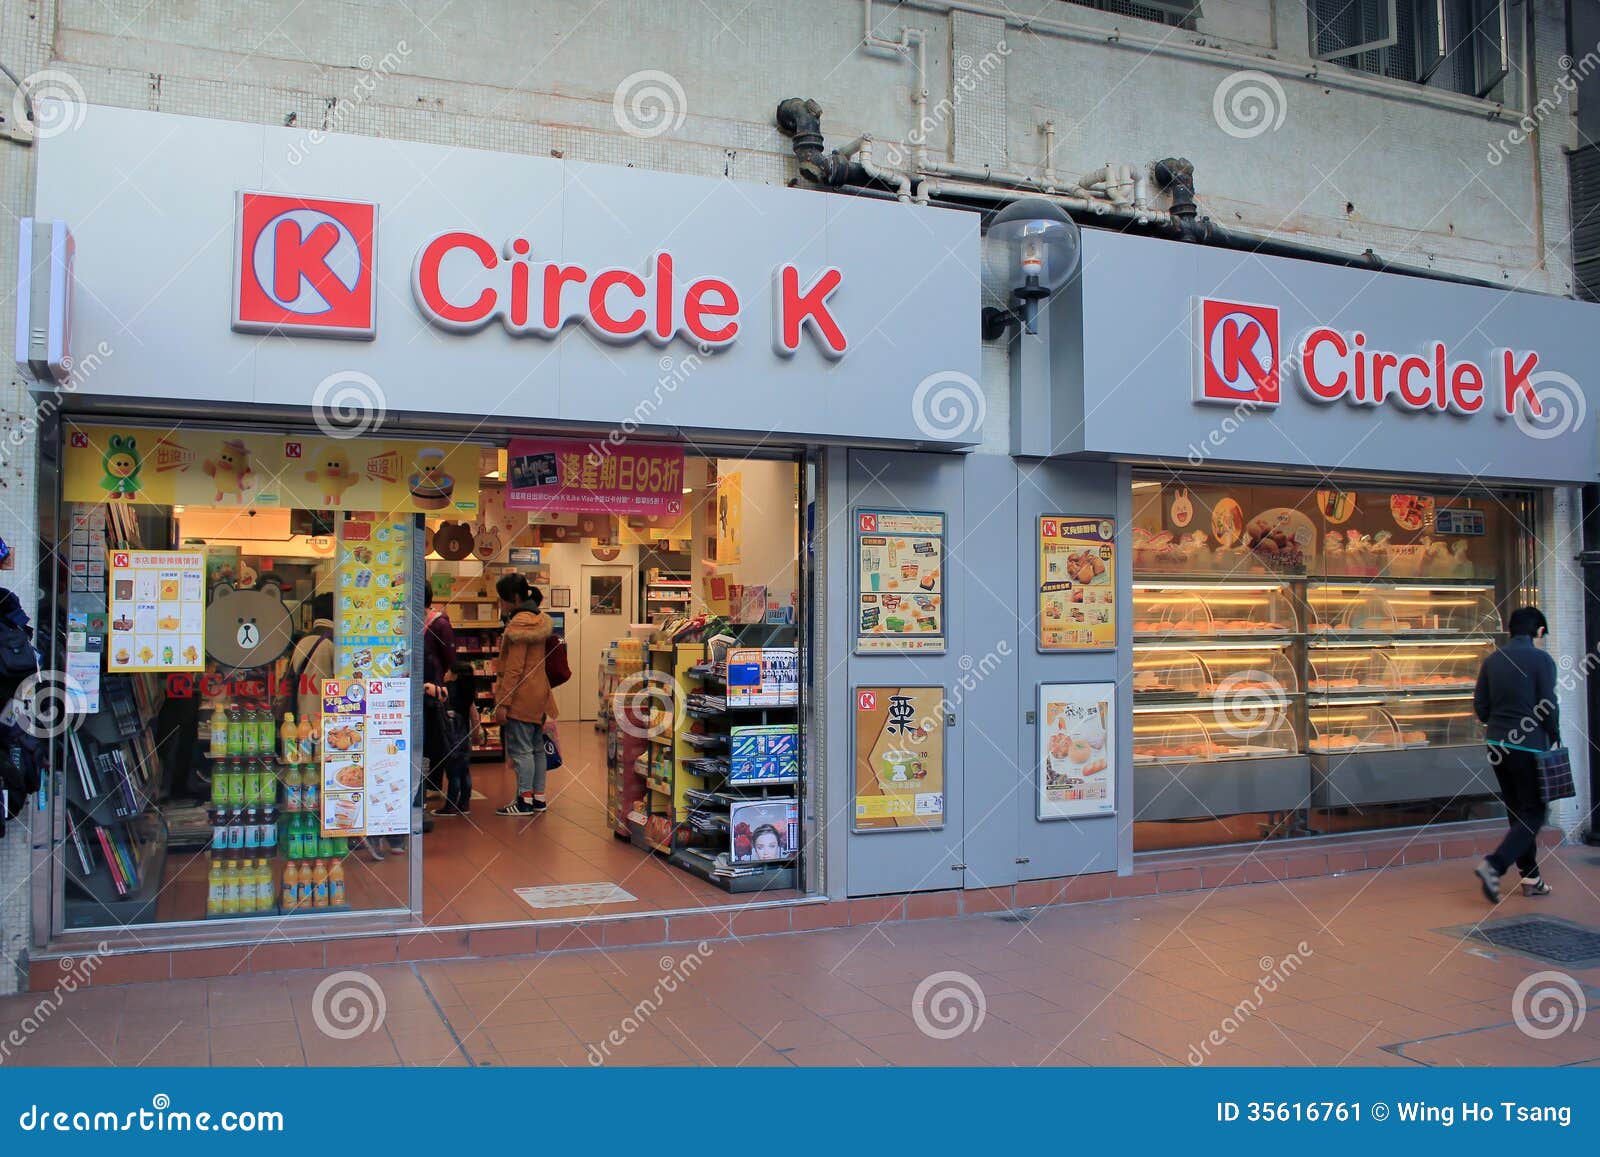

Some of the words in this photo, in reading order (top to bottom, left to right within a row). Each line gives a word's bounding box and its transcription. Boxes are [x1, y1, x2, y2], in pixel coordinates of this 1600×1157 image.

[271, 218, 355, 314] K
[419, 232, 740, 342] Circle
[783, 267, 847, 351] K
[1221, 316, 1275, 392] K
[1303, 329, 1484, 412] Circle
[1503, 349, 1543, 416] K
[286, 443, 301, 457] K
[562, 453, 681, 493] 逢星期日95折
[860, 514, 877, 532] K
[1043, 521, 1057, 537] K
[114, 553, 128, 567] K
[300, 673, 319, 696] K
[326, 682, 339, 697] K
[369, 681, 383, 695] K
[859, 692, 876, 710] K
[887, 696, 917, 736] 栗
